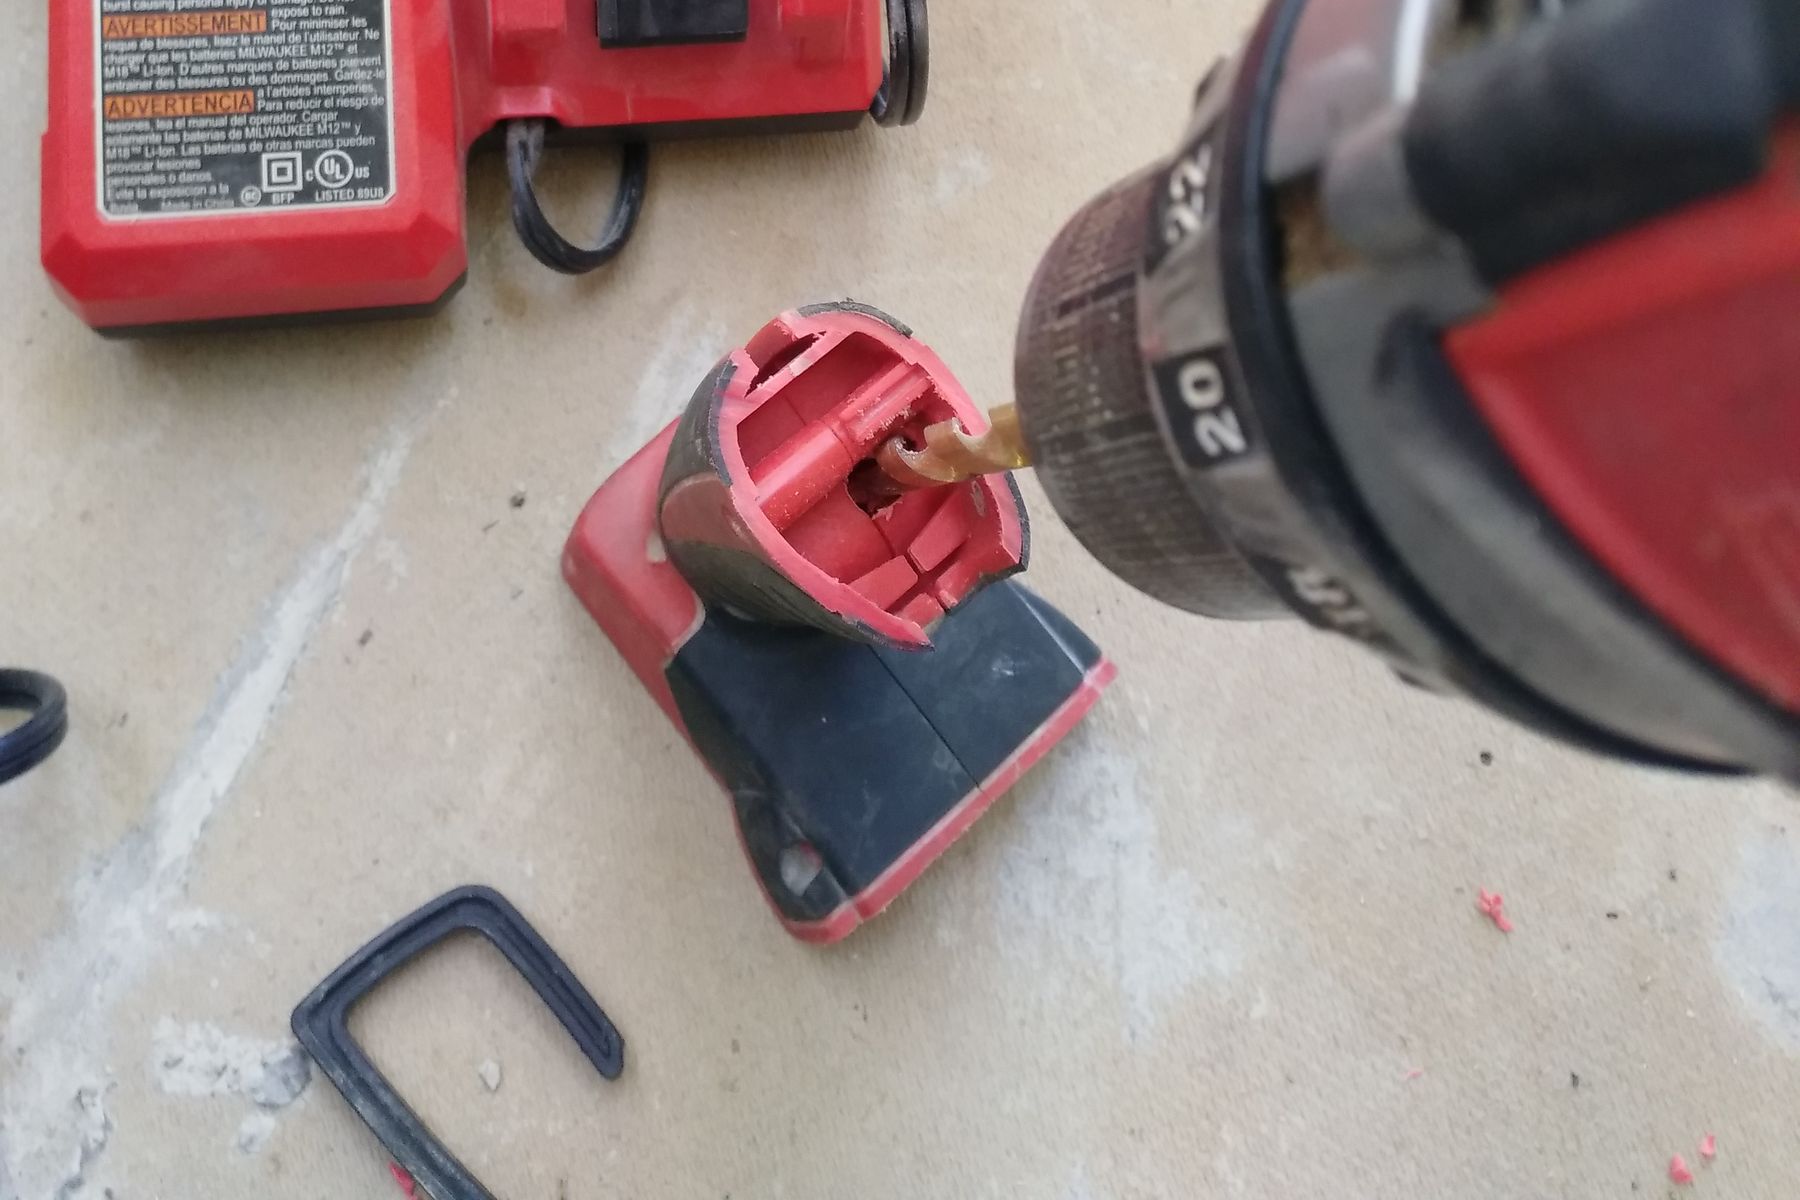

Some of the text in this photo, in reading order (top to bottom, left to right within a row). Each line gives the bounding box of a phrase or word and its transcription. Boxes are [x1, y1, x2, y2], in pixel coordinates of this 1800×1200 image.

[271, 6, 309, 19] expose
[311, 4, 323, 17] to
[106, 13, 263, 37] AVERTISSEMENT
[271, 15, 368, 32] Pour minimiser les
[240, 32, 251, 46] le
[288, 31, 302, 44] de
[364, 28, 381, 41] Ne
[238, 43, 308, 60] MILWAUKEE
[346, 42, 359, 55] et
[226, 60, 273, 75] marques
[275, 59, 290, 72] de
[291, 57, 338, 71] batteries
[231, 75, 246, 87] ou
[247, 73, 268, 86] des
[334, 67, 386, 82] Gardez-le
[108, 92, 253, 116] ADVERTENCIA
[257, 94, 385, 112] Para reducir el riesgo de
[229, 114, 247, 127] del
[301, 109, 339, 124] Cargar
[245, 123, 315, 140] MILWAUKEE
[354, 123, 361, 134] y
[248, 140, 263, 154] de
[265, 138, 293, 152] otras
[294, 136, 335, 151] marcas
[336, 135, 376, 150] pueden
[315, 188, 355, 202] LISTED
[1177, 357, 1247, 457] 20
